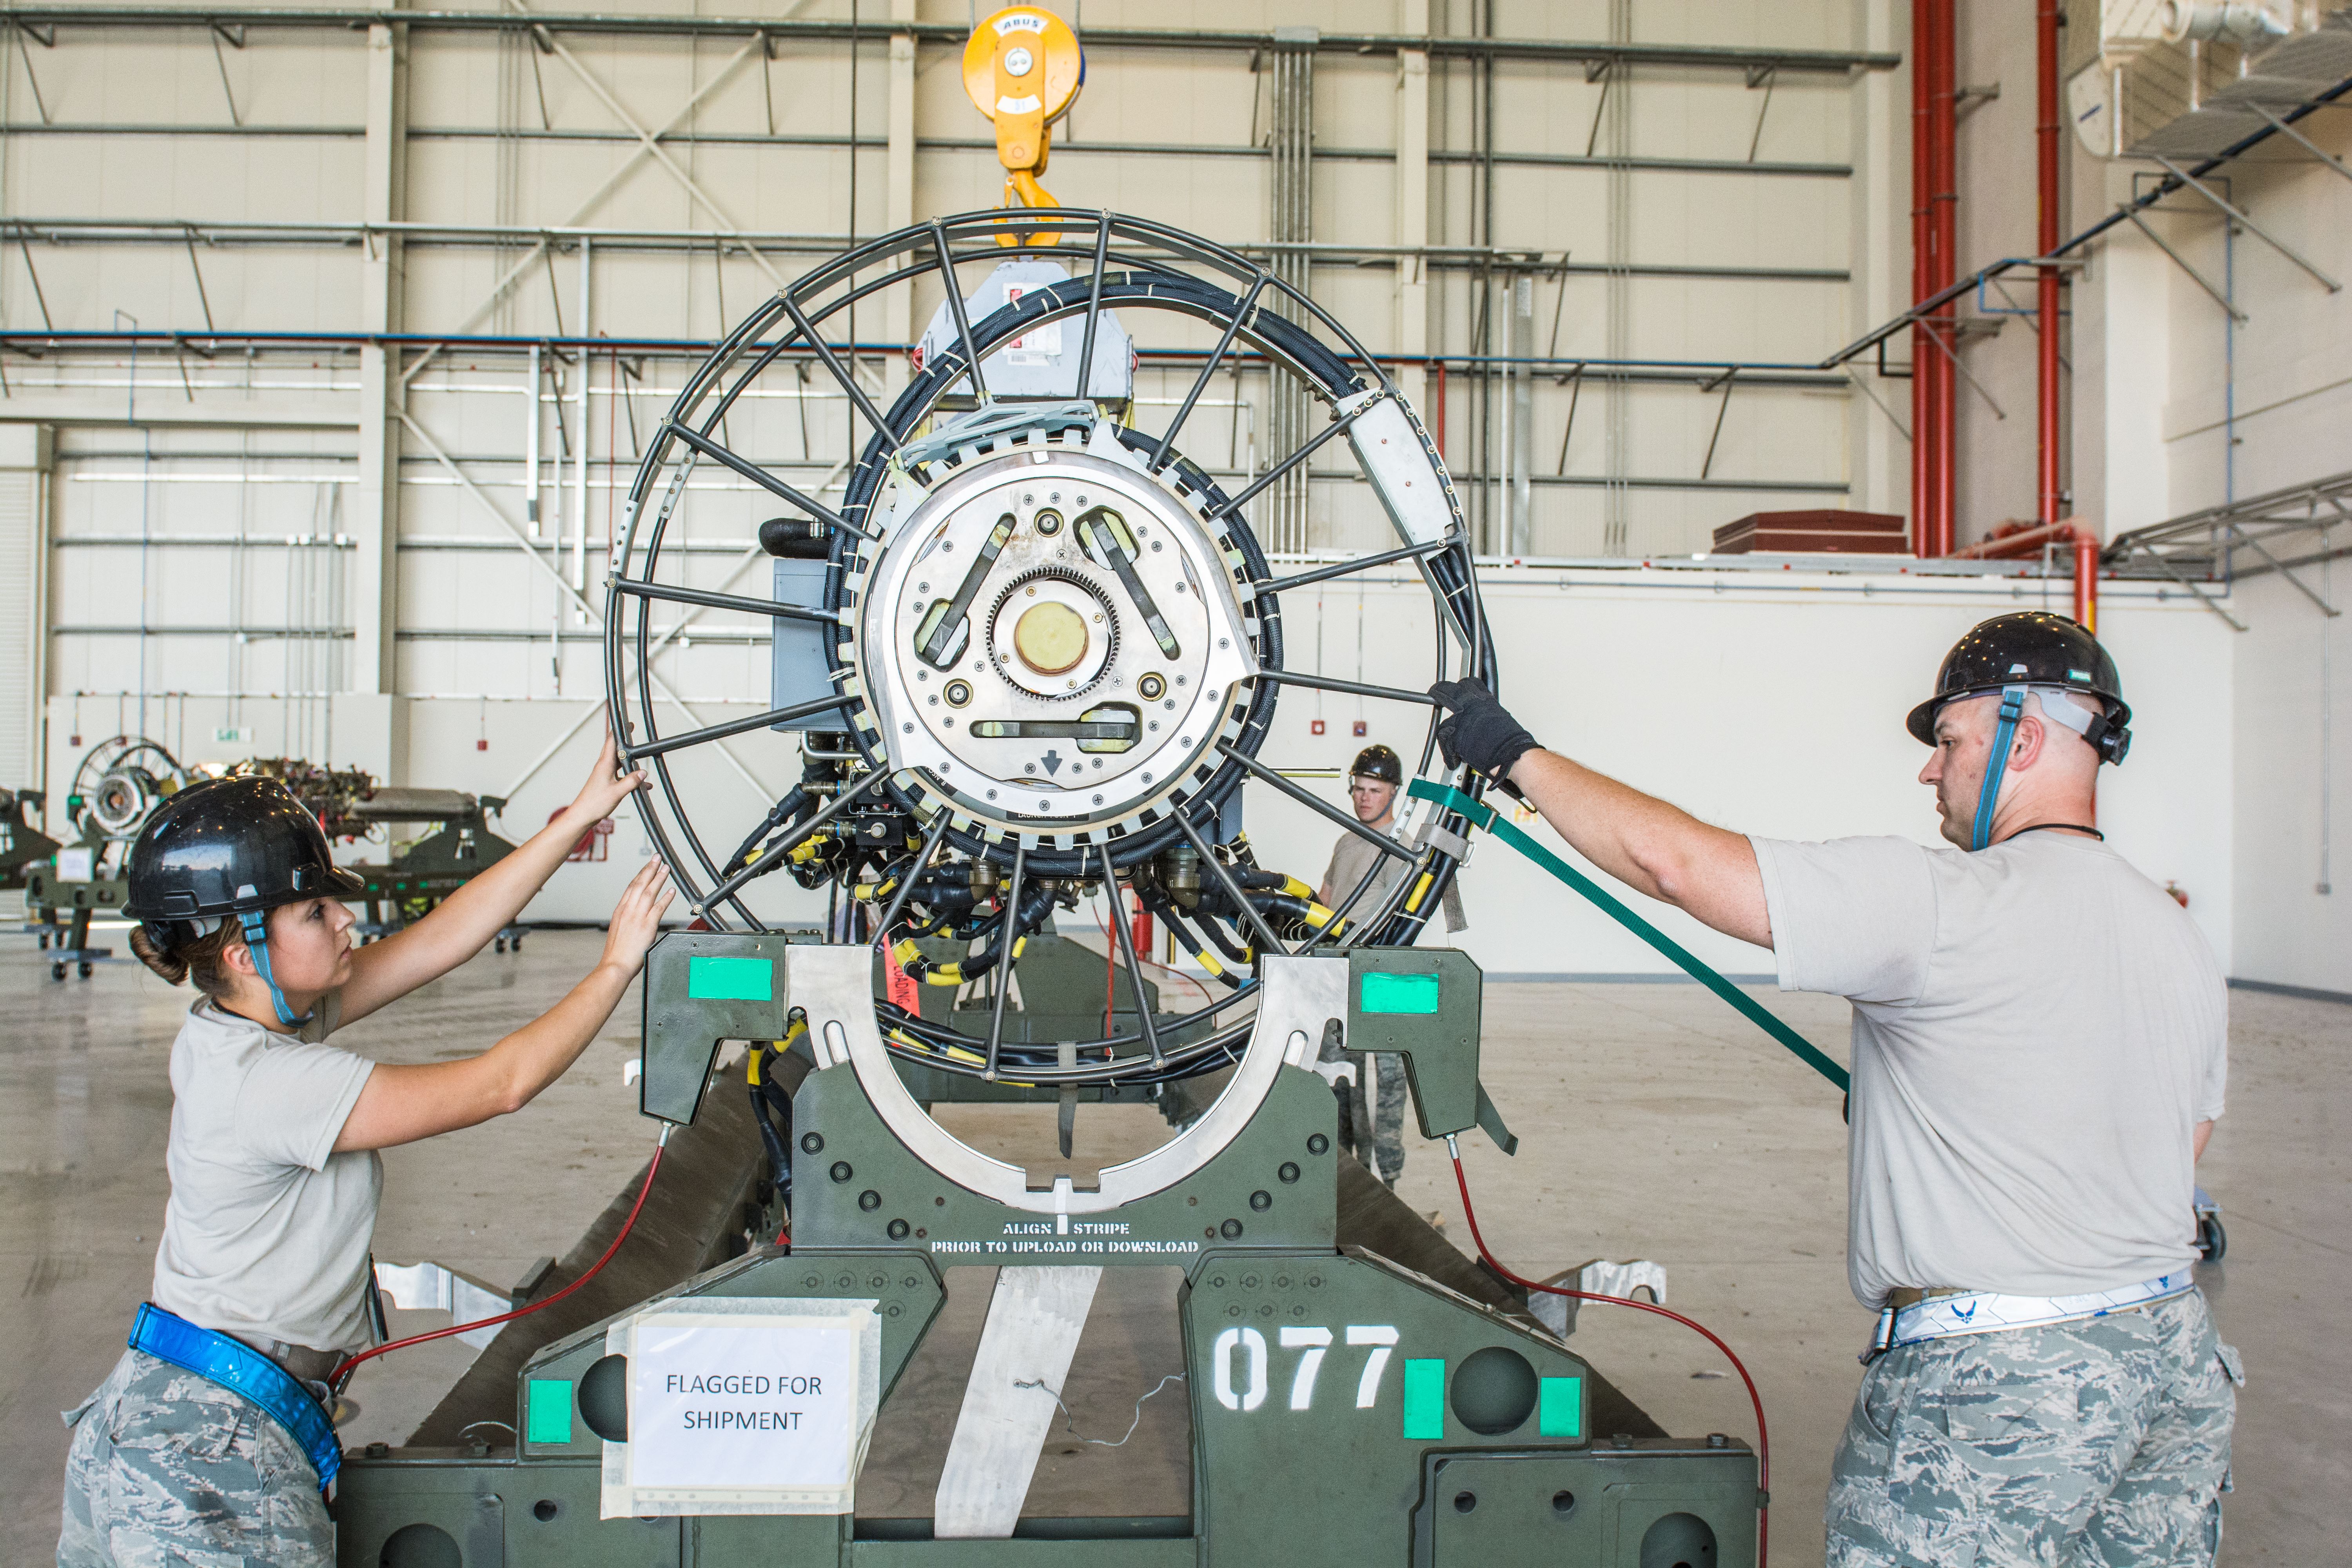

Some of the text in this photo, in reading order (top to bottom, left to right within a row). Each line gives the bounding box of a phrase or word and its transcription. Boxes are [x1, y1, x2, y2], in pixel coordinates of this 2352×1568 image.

[1004, 18, 1039, 29] ABUS
[1003, 1223, 1130, 1234] ALIGN STRIPE
[931, 1241, 1199, 1252] PRIOR TO UPLOAD OR DOWNLOAD
[1214, 1326, 1399, 1410] 077
[667, 1375, 822, 1395] FLAGGED FOR
[684, 1411, 803, 1430] SHIPMENT
